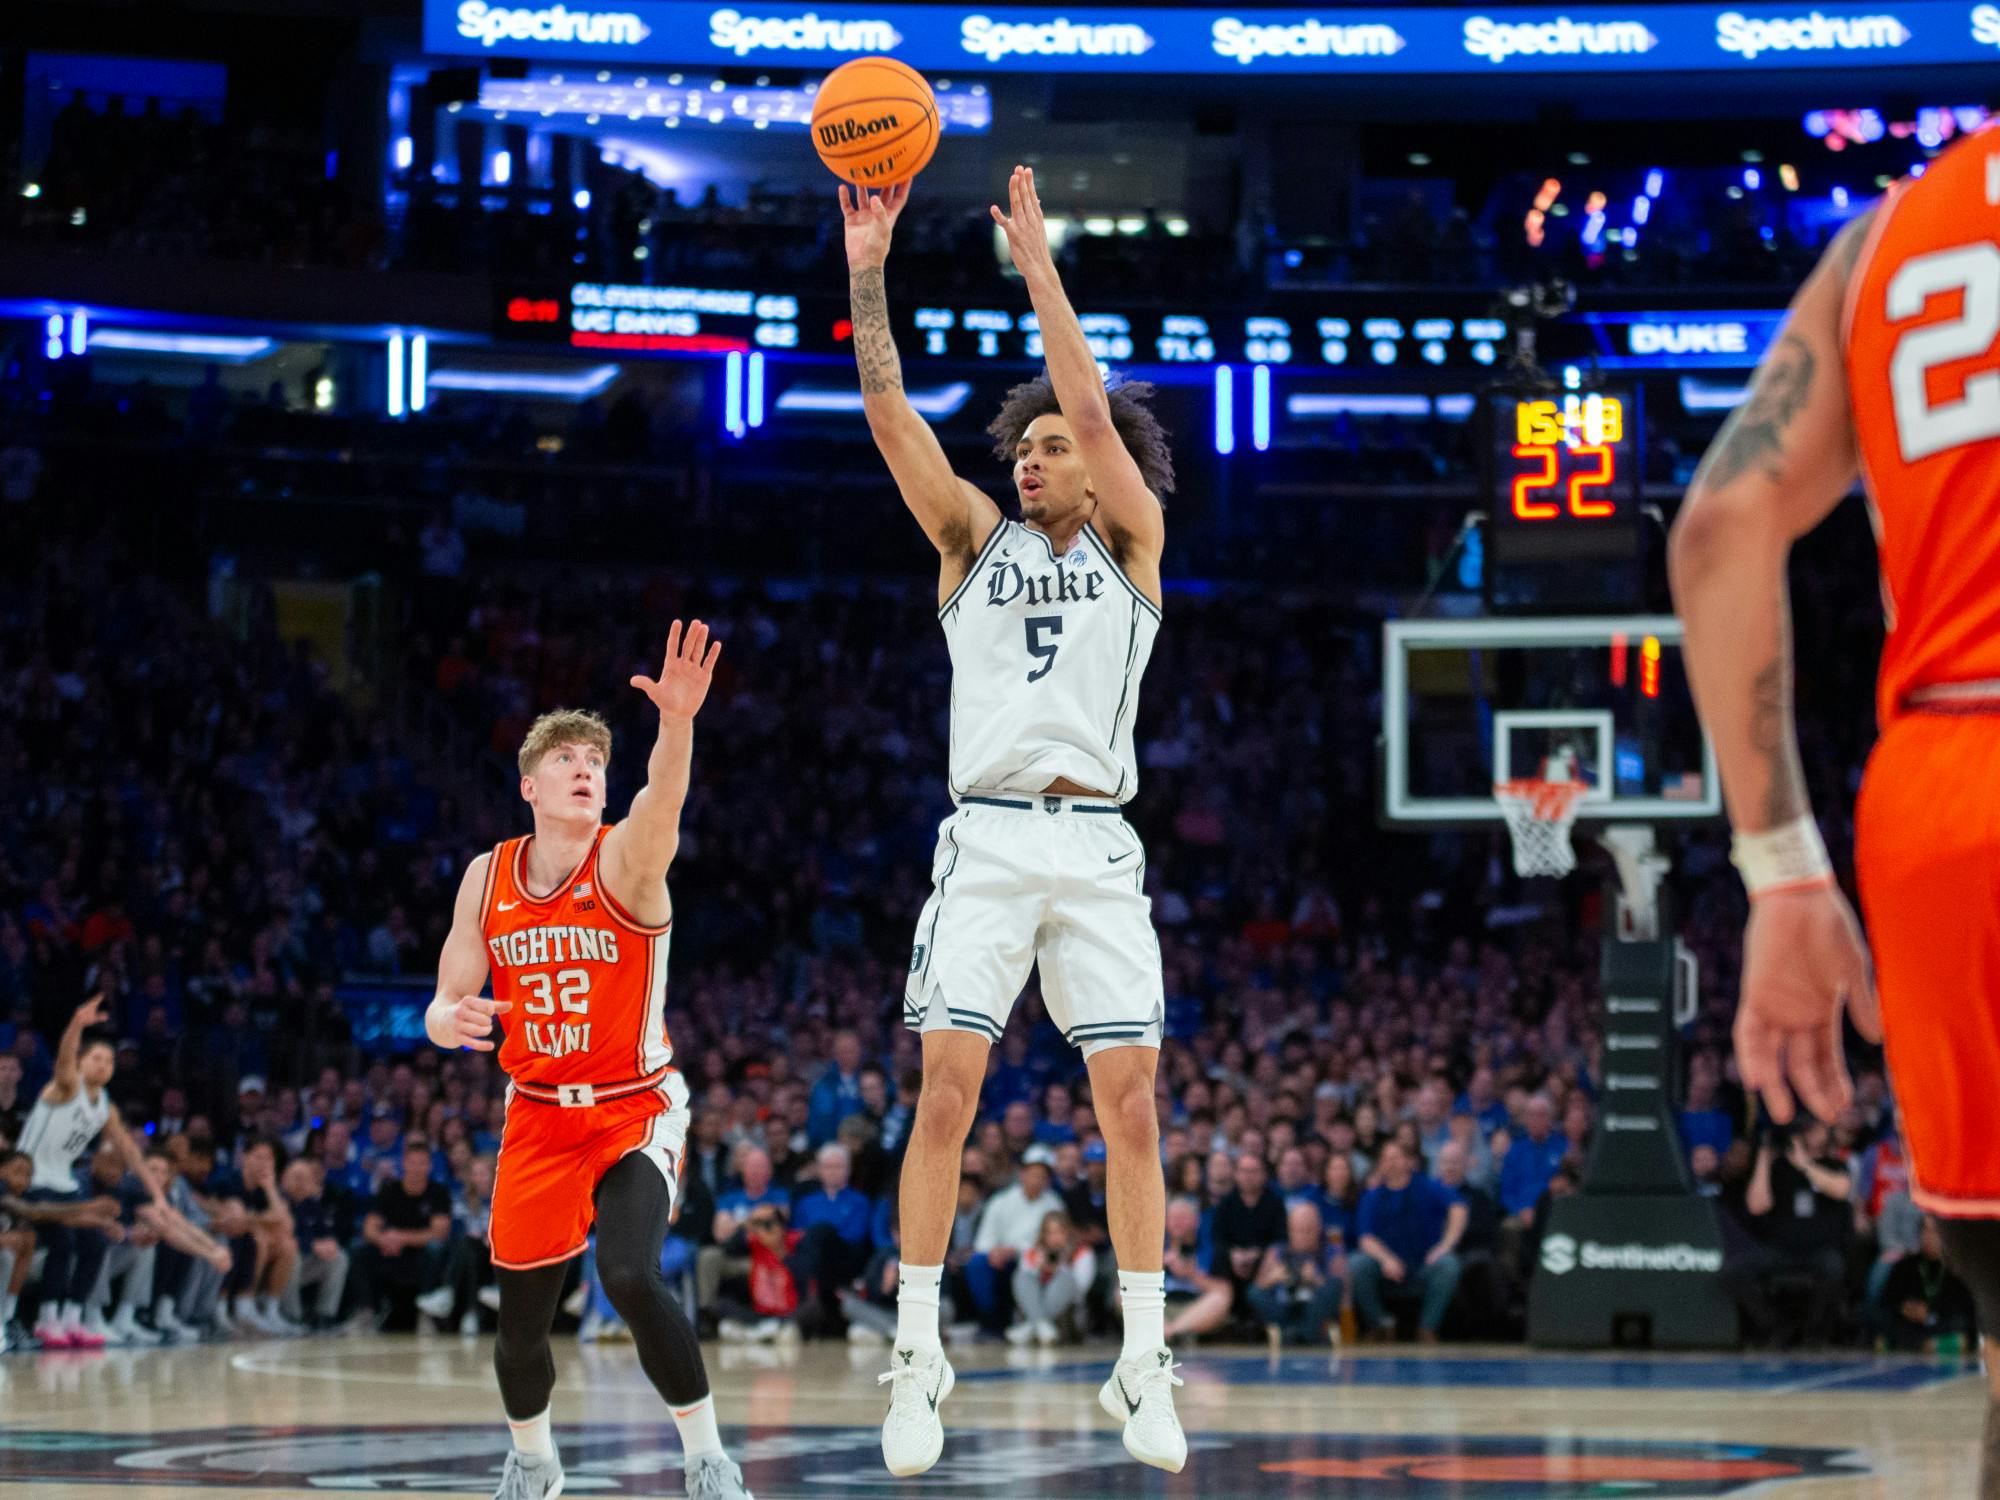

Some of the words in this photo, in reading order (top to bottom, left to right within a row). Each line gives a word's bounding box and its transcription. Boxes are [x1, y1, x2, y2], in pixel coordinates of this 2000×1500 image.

[458, 1, 645, 46] Spectrum
[711, 10, 898, 54] Spectrum
[962, 17, 1149, 60] Spectrum
[1213, 19, 1401, 63] Spectrum
[1465, 18, 1652, 62] Spectrum
[1718, 14, 1905, 58] Spectrum
[819, 113, 898, 147] Wilson
[1632, 324, 1746, 353] DUKE
[1511, 446, 1615, 519] 22
[986, 561, 1105, 607] Duke
[1024, 615, 1063, 683] 5
[487, 926, 620, 968] FIGHTING
[519, 969, 591, 1016] 32
